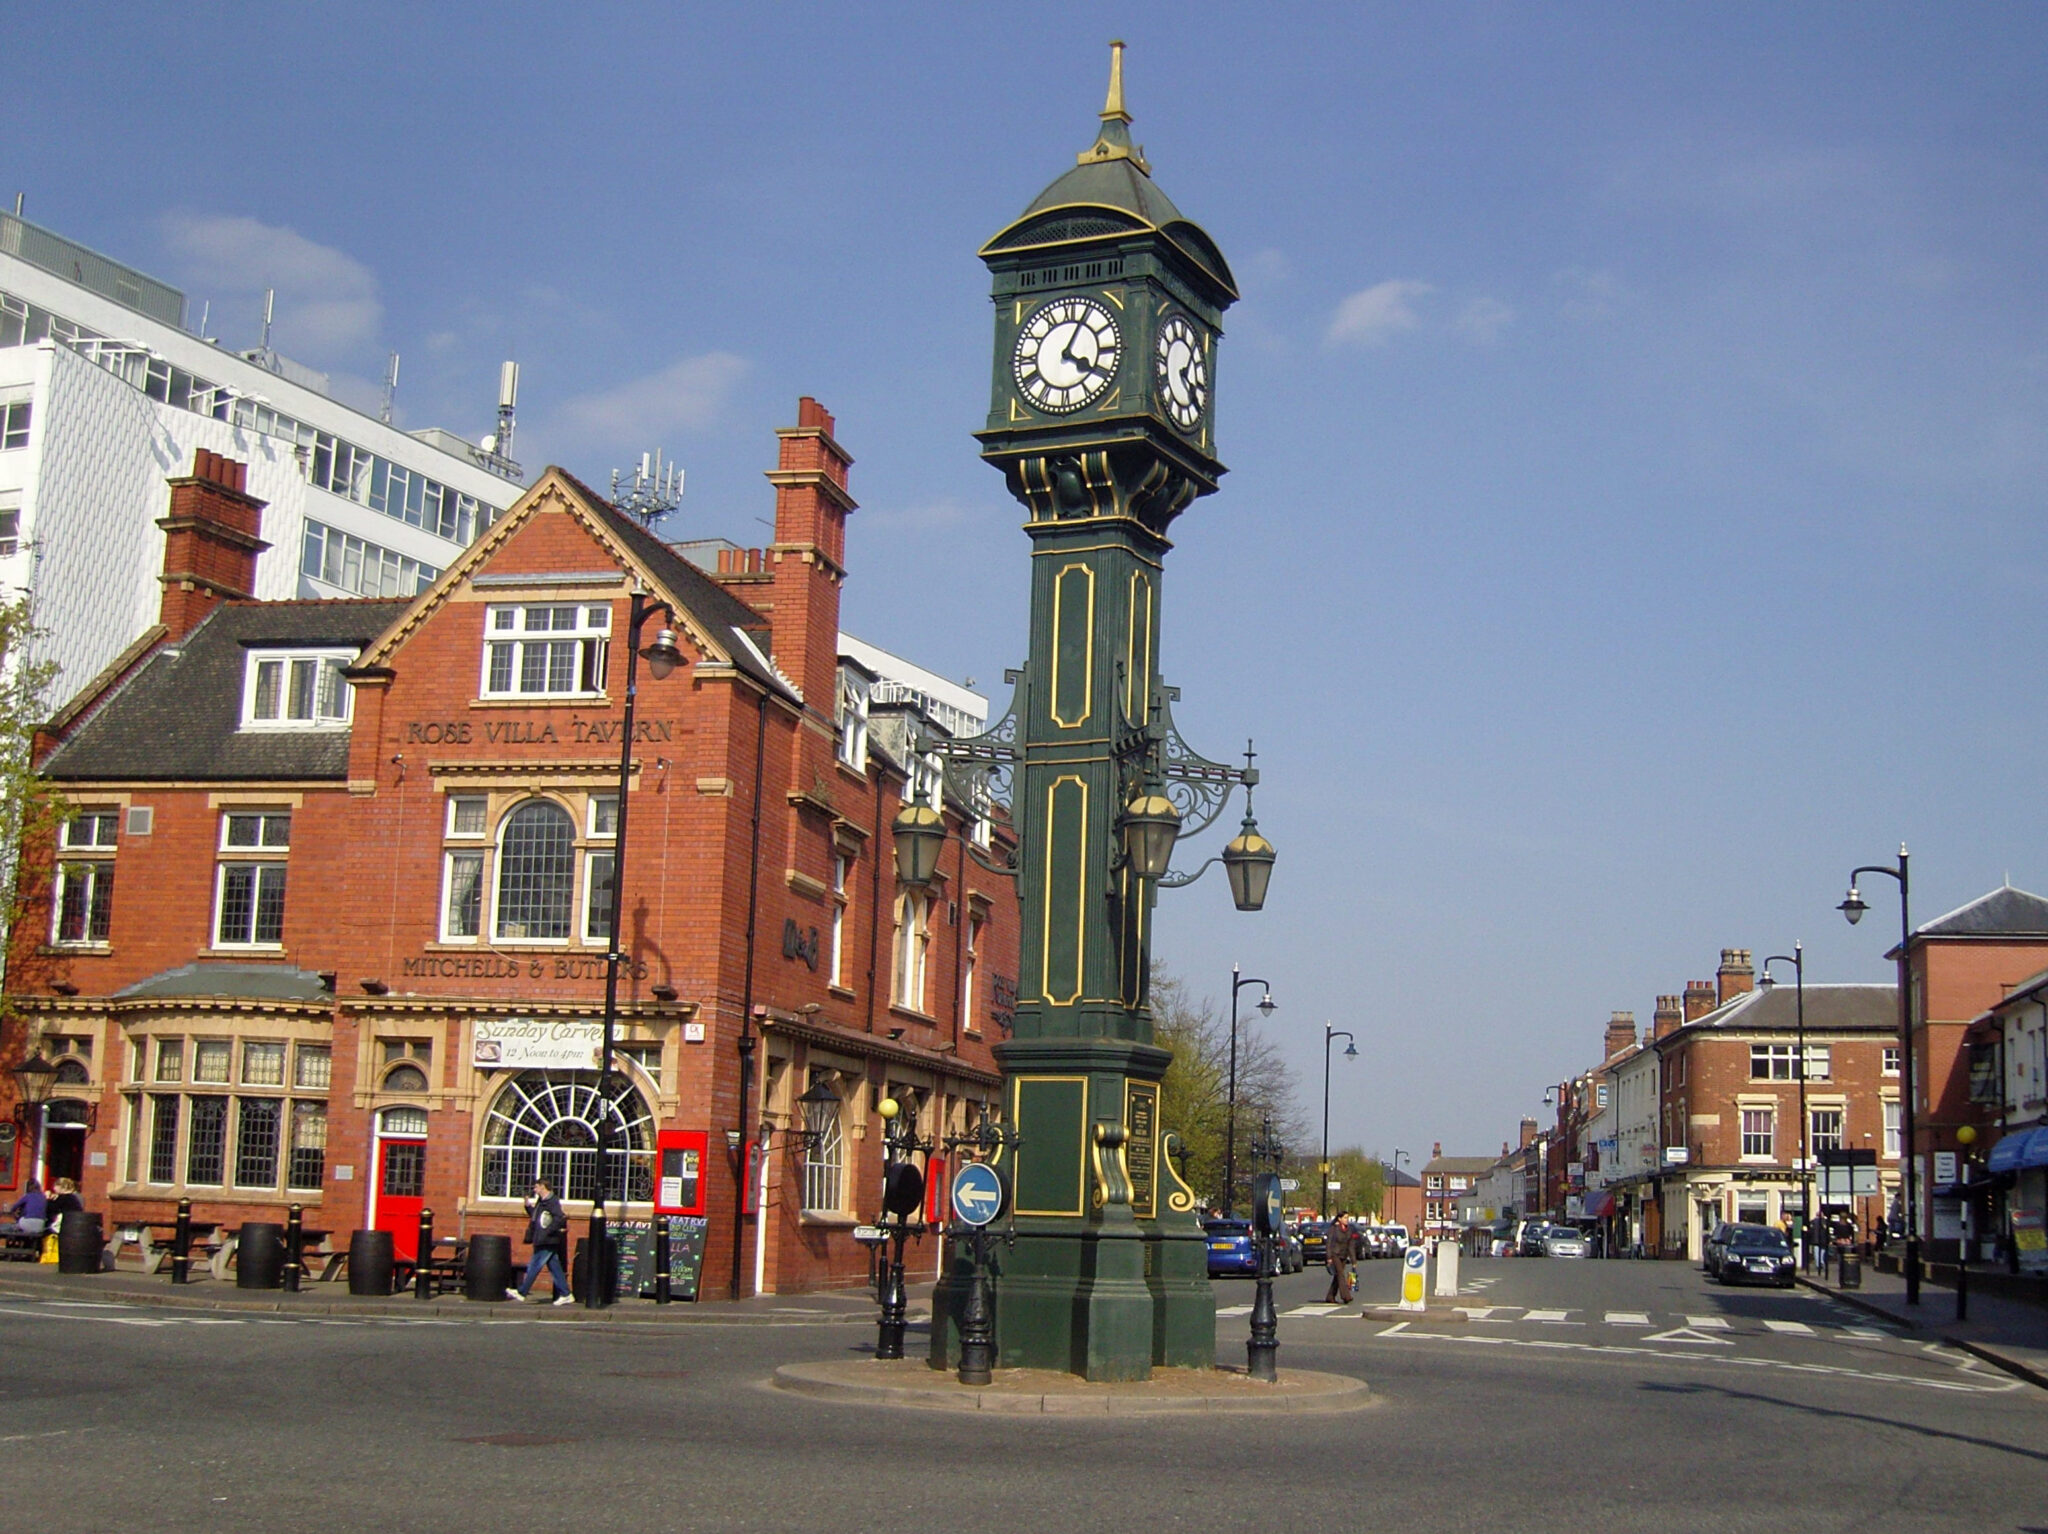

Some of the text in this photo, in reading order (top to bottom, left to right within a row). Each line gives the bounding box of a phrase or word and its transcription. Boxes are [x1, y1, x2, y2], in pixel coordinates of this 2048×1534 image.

[407, 722, 473, 744] ROSE
[484, 722, 559, 744] VILLA
[403, 957, 519, 979] MITCHELLS
[528, 959, 545, 979] &
[476, 1021, 547, 1043] Sunday
[506, 1046, 584, 1061] 12 Noon to 4pm
